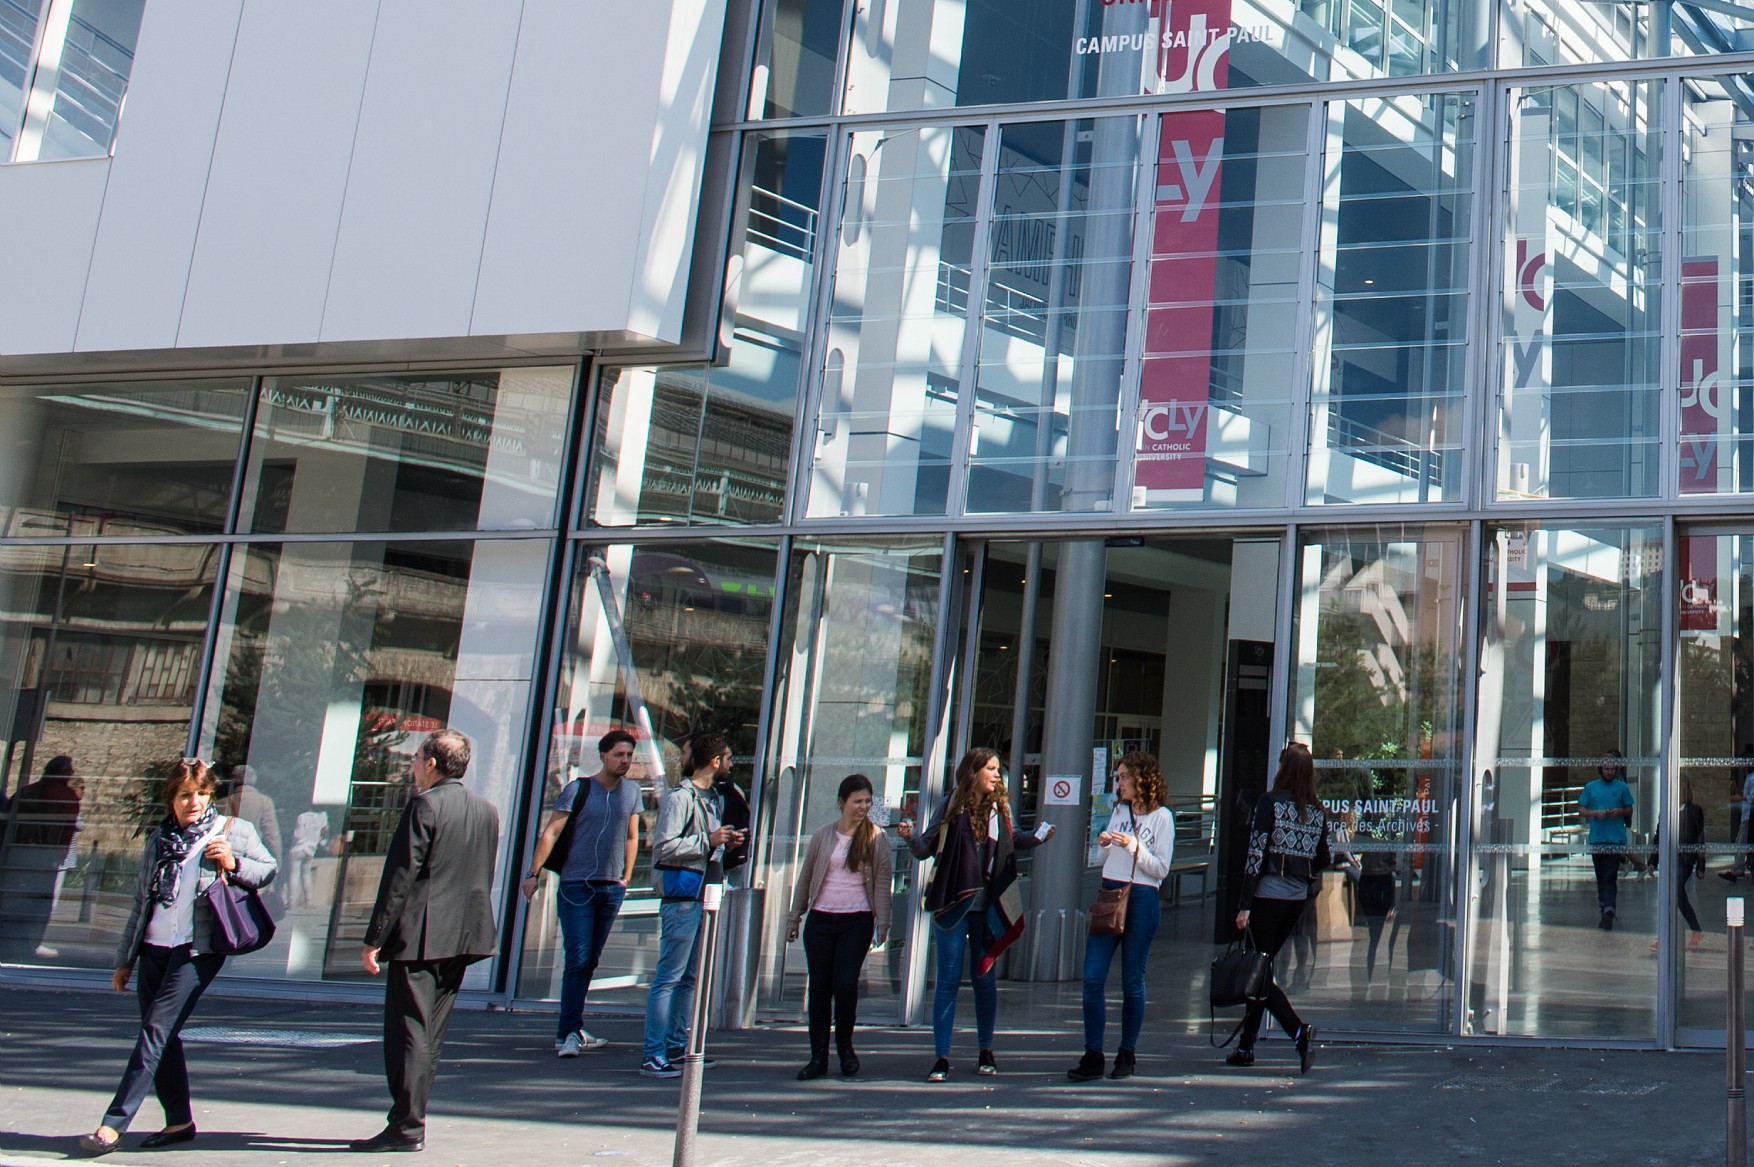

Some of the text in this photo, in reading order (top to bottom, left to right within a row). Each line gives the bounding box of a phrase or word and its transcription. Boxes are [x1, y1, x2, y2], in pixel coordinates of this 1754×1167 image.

[1076, 24, 1273, 55] CAMPUS SAINT PAUL
[1152, 443, 1191, 452] CATHOLIC
[1322, 799, 1350, 814] PUS
[1326, 820, 1347, 832] ace
[1351, 818, 1373, 832] des
[1379, 818, 1430, 832] Archives
